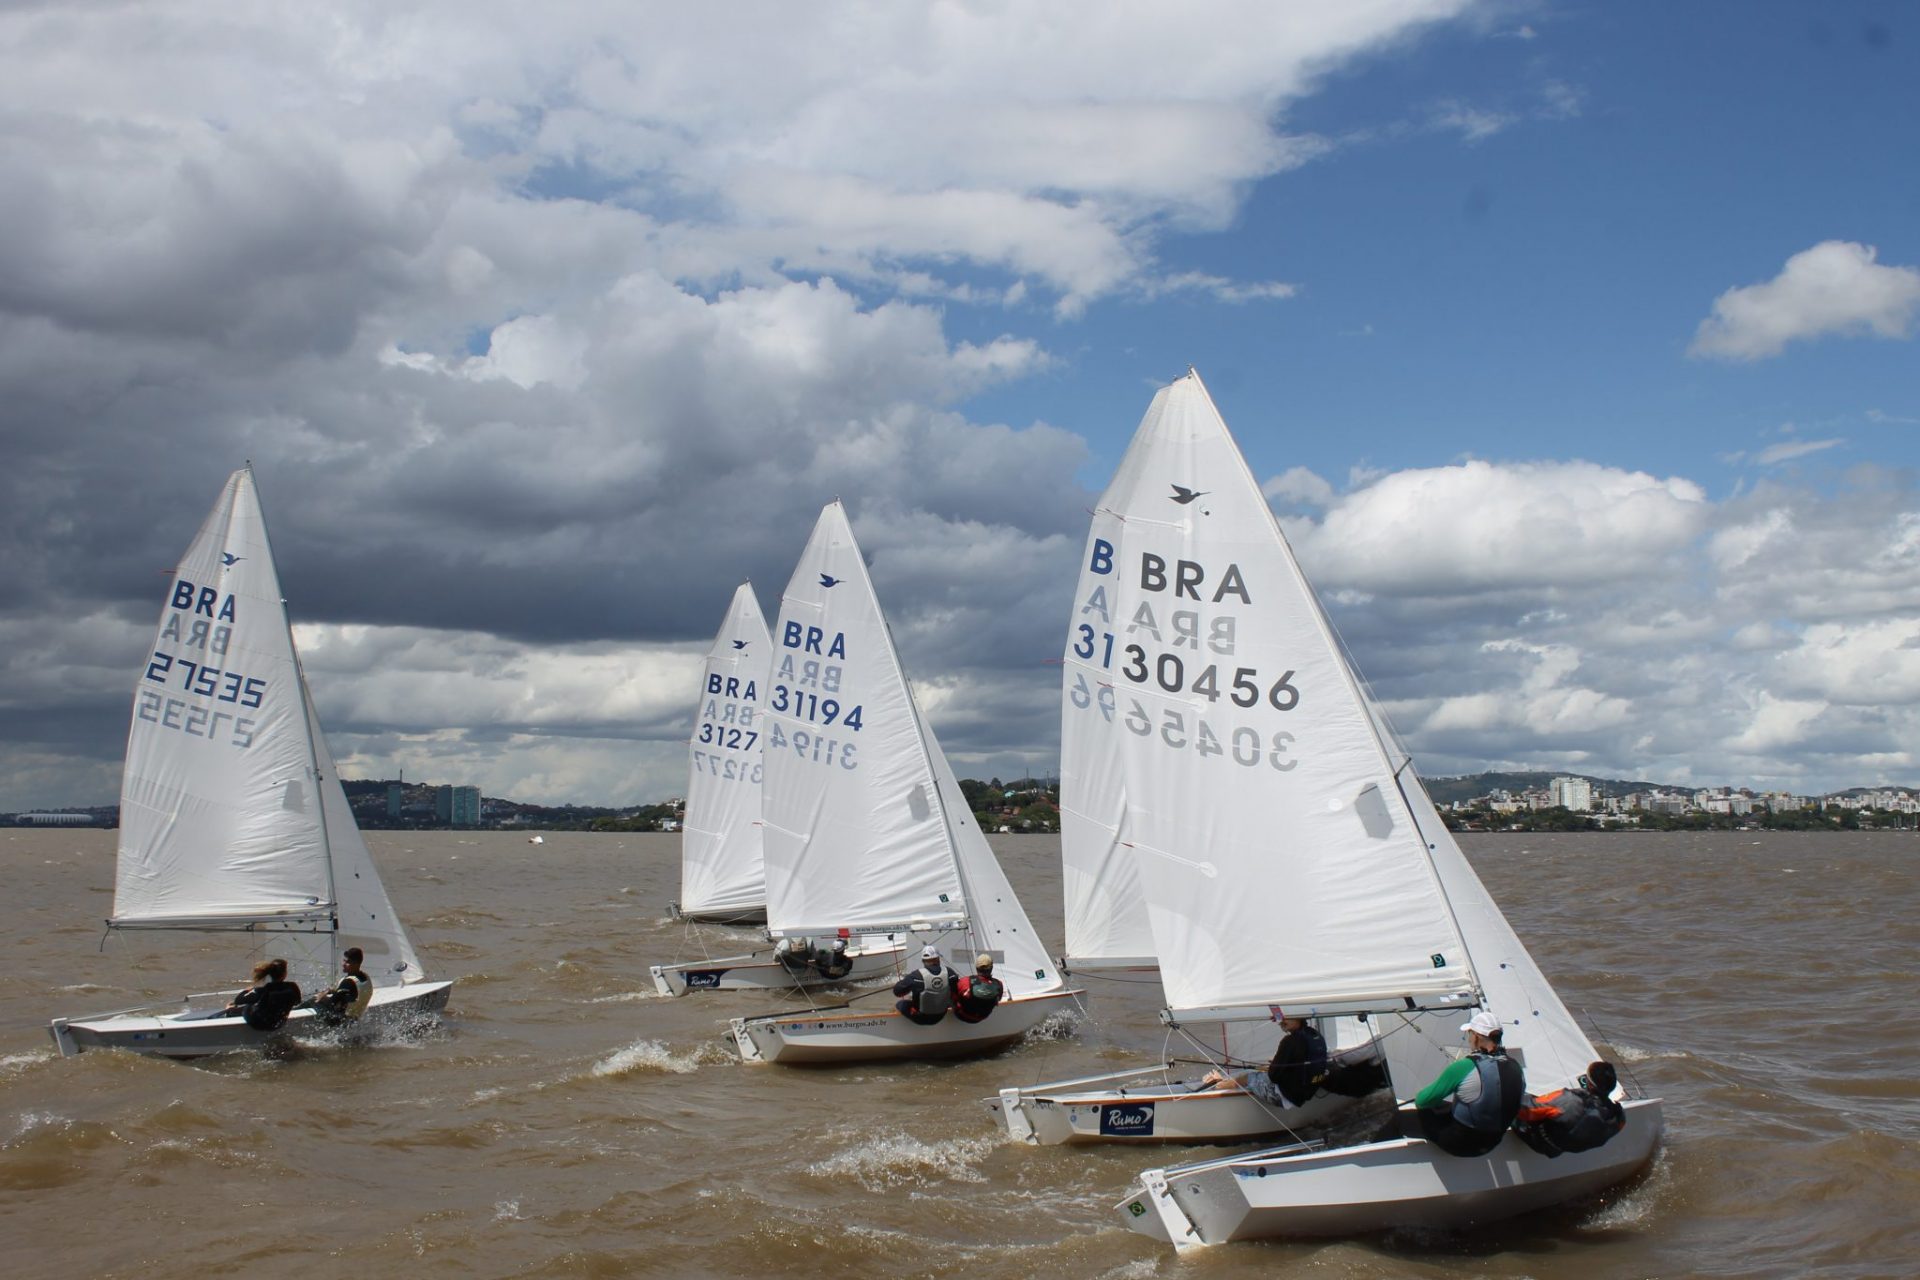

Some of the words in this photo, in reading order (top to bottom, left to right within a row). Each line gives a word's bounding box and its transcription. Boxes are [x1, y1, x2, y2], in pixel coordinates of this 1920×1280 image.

[1141, 551, 1252, 605] BRA
[171, 579, 236, 624] BRA
[783, 620, 846, 660] BRA
[146, 651, 267, 709] 27535
[708, 673, 757, 702] BRA
[1122, 643, 1300, 712] 30456
[771, 684, 863, 732] 31194
[698, 723, 758, 751] 3127
[1108, 1109, 1142, 1126] Rumo
